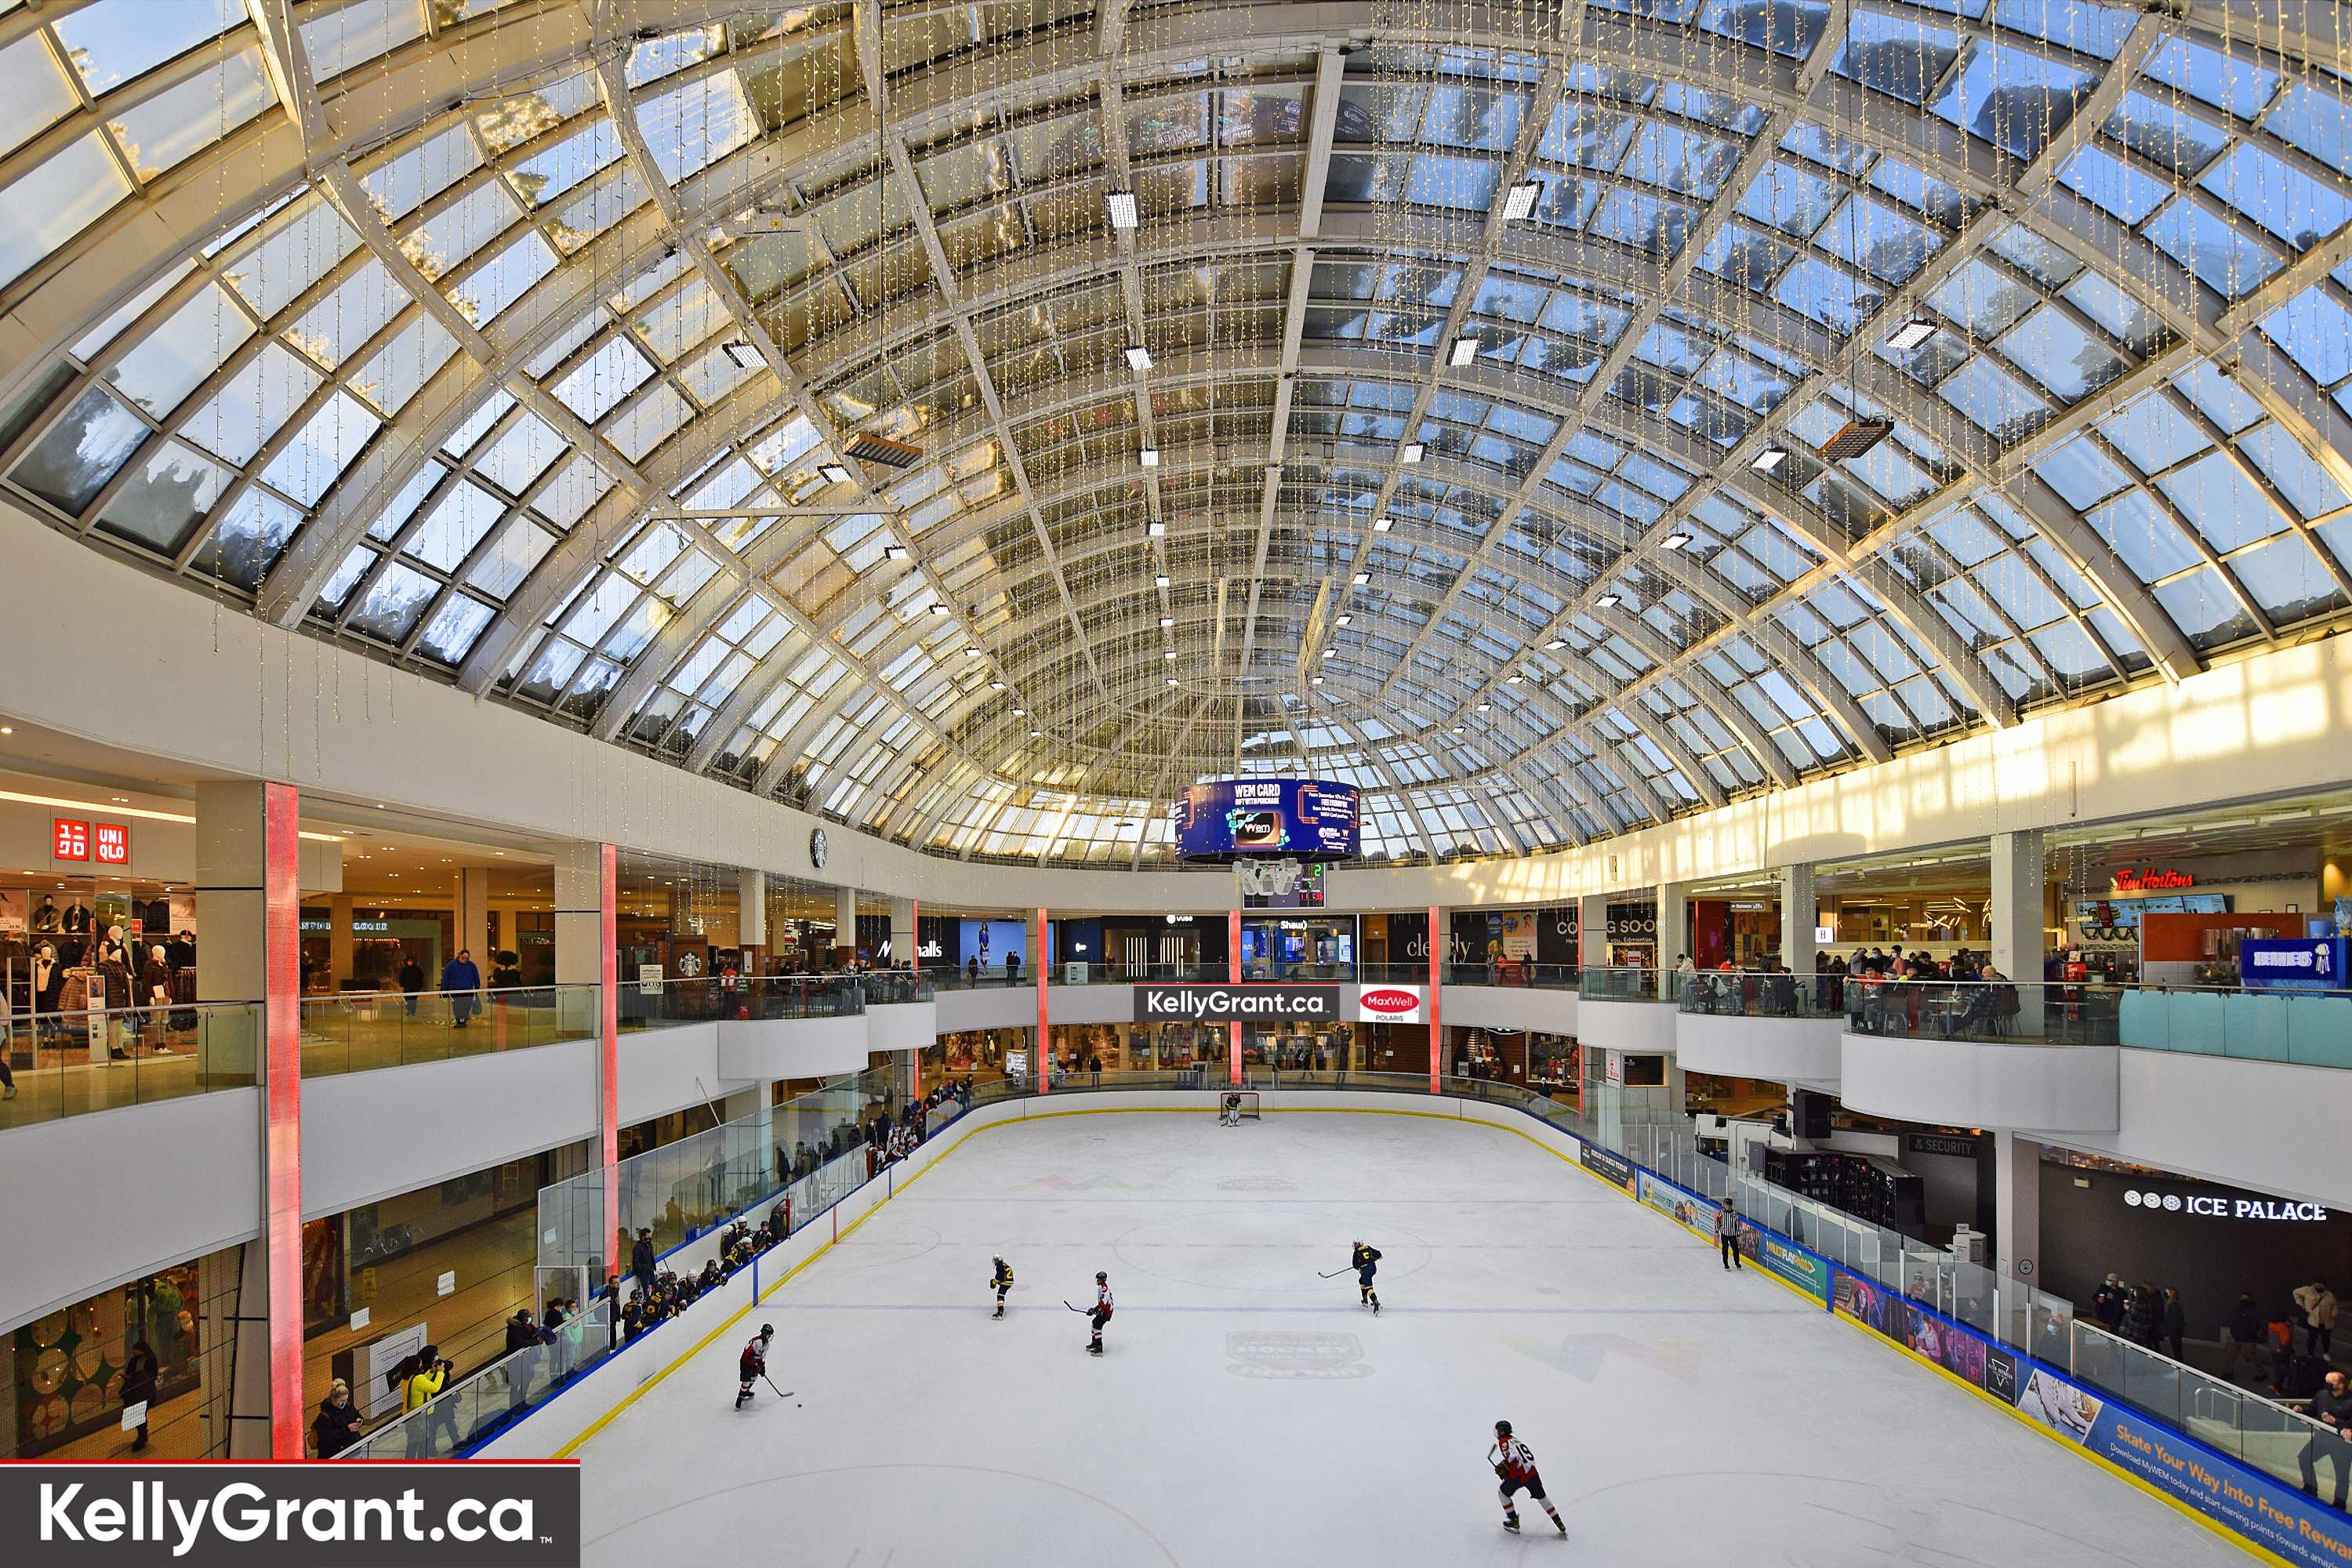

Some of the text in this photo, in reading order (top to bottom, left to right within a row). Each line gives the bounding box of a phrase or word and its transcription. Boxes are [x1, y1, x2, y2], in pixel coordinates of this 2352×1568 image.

[1235, 784, 1280, 797] WEM CARD
[100, 829, 122, 844] UNI
[100, 844, 124, 860] QLO
[1315, 865, 1321, 877] 2
[2116, 867, 2193, 891] Tim Hortons
[1620, 919, 1656, 933] SOO
[1407, 933, 1471, 964] clely
[1926, 1139, 1972, 1154] SECURITY
[2187, 1196, 2327, 1221] ICE PALACE
[2117, 1424, 2151, 1454] Skate
[2154, 1443, 2186, 1472] Your
[2189, 1461, 2220, 1493] Way
[2224, 1480, 2255, 1508] Into
[2258, 1497, 2296, 1530] Free
[2111, 1443, 2141, 1465] Download
[2142, 1460, 2169, 1481] MyWEM
[2170, 1476, 2189, 1494] today
[2190, 1486, 2203, 1500] and
[2205, 1495, 2221, 1510] start
[2222, 1505, 2249, 1527] earning
[2251, 1520, 2274, 1539] points
[2276, 1533, 2309, 1556] towards
